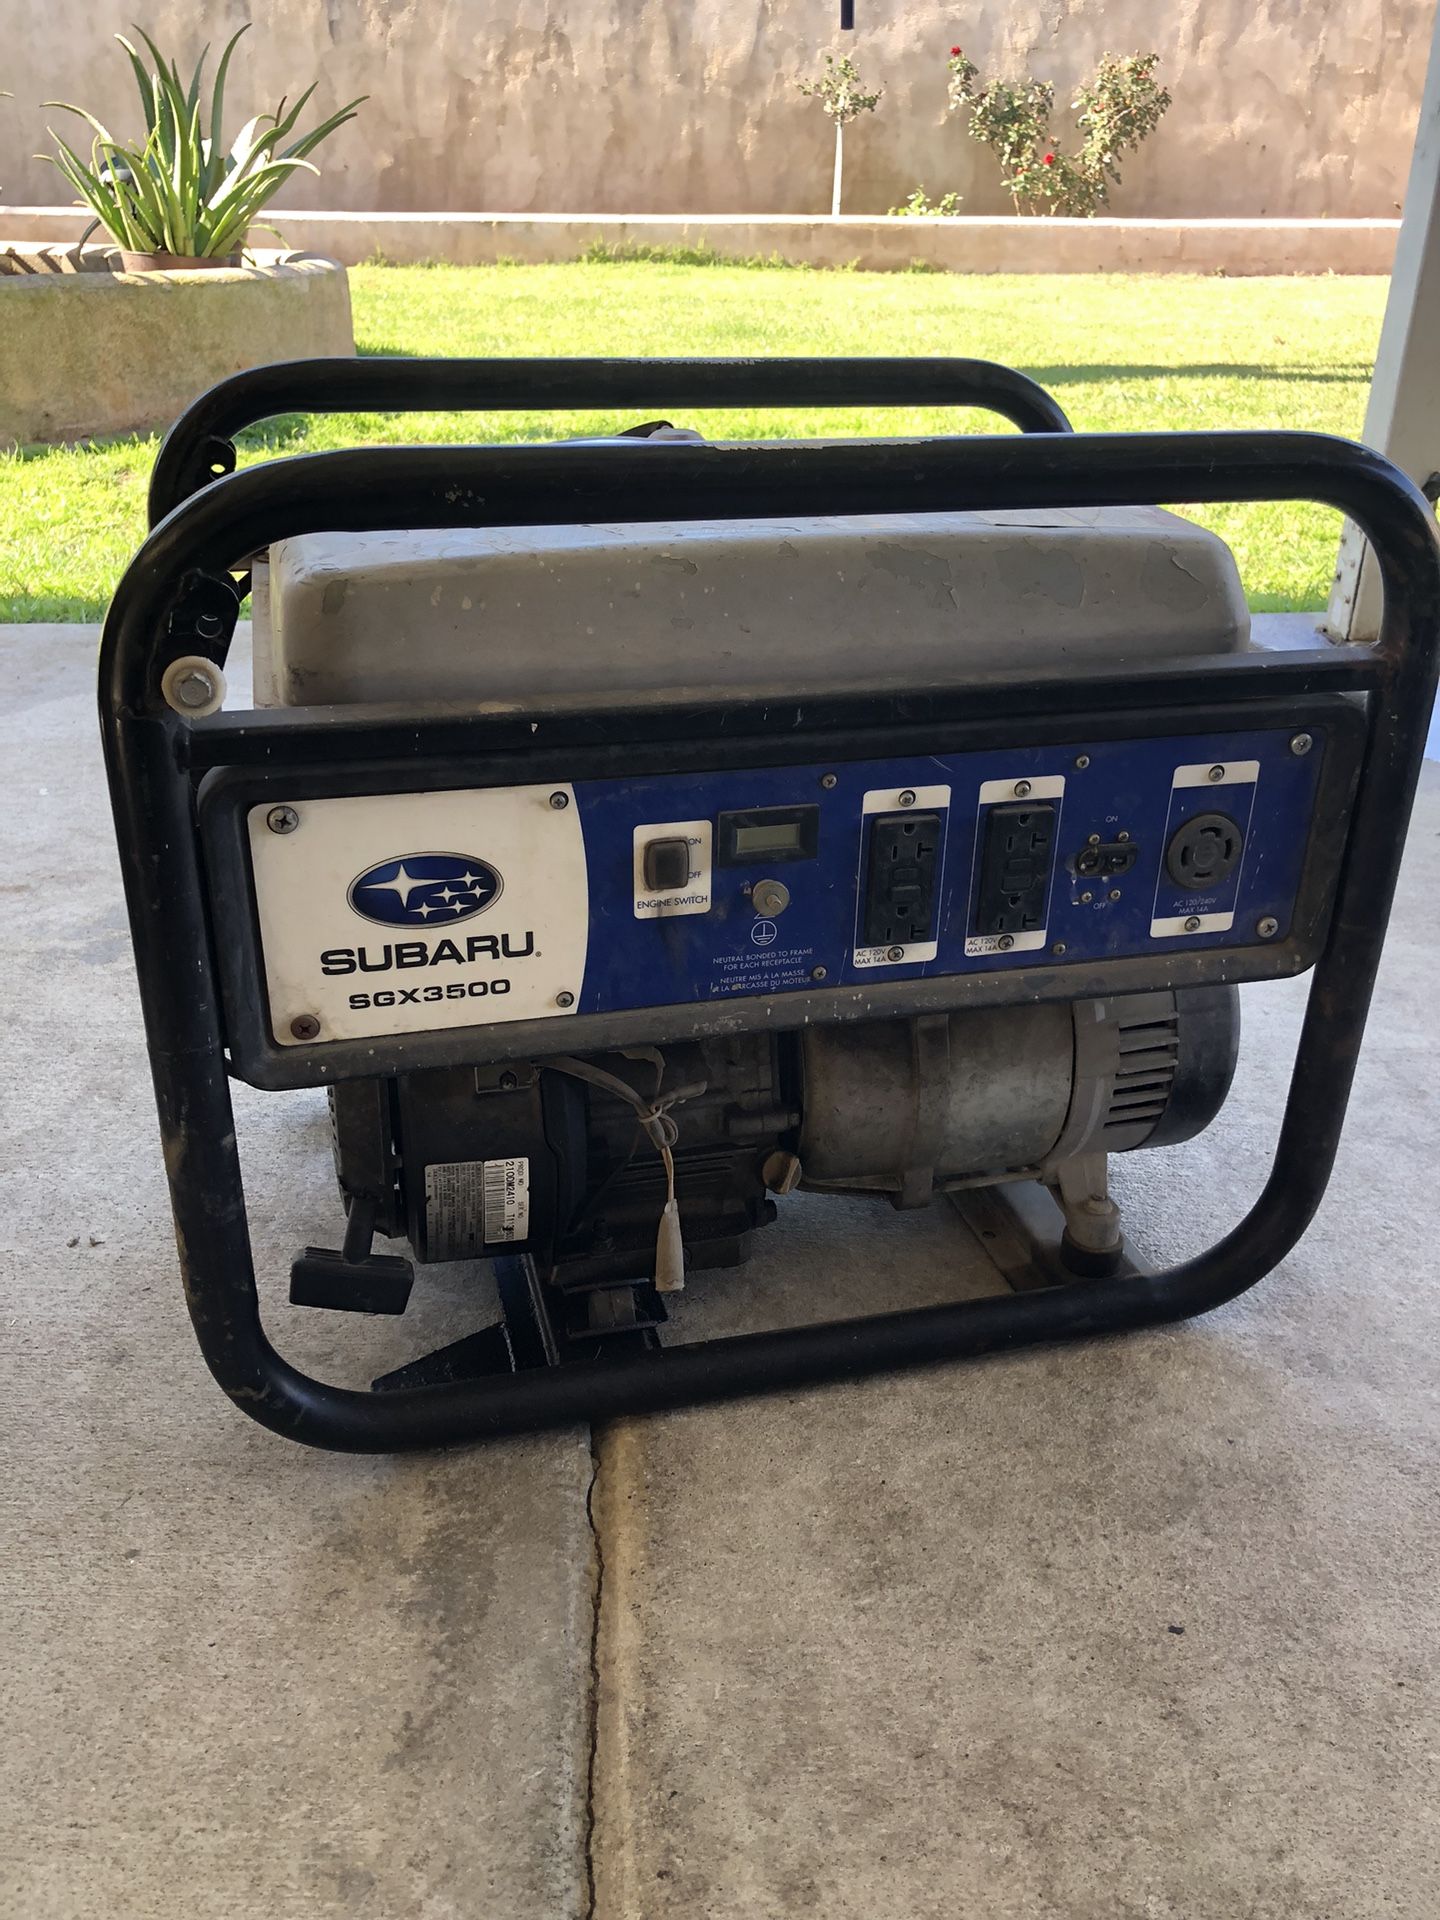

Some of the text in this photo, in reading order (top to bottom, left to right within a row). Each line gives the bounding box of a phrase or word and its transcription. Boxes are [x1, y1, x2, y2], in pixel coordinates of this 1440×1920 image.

[688, 838, 702, 846] ON
[687, 871, 702, 879] OFF
[637, 896, 708, 909] ENGINE SWITCH
[320, 931, 534, 976] SUBARU
[712, 956, 744, 964] NEUTRAL
[746, 952, 776, 961] BONDED
[790, 948, 813, 956] FRAME
[966, 946, 983, 954] MAX
[723, 957, 803, 971] FOR EACH RECEPTACLE
[720, 976, 747, 984] NEUTRE
[781, 969, 805, 977] MASSE
[349, 979, 511, 1010] SGX3500
